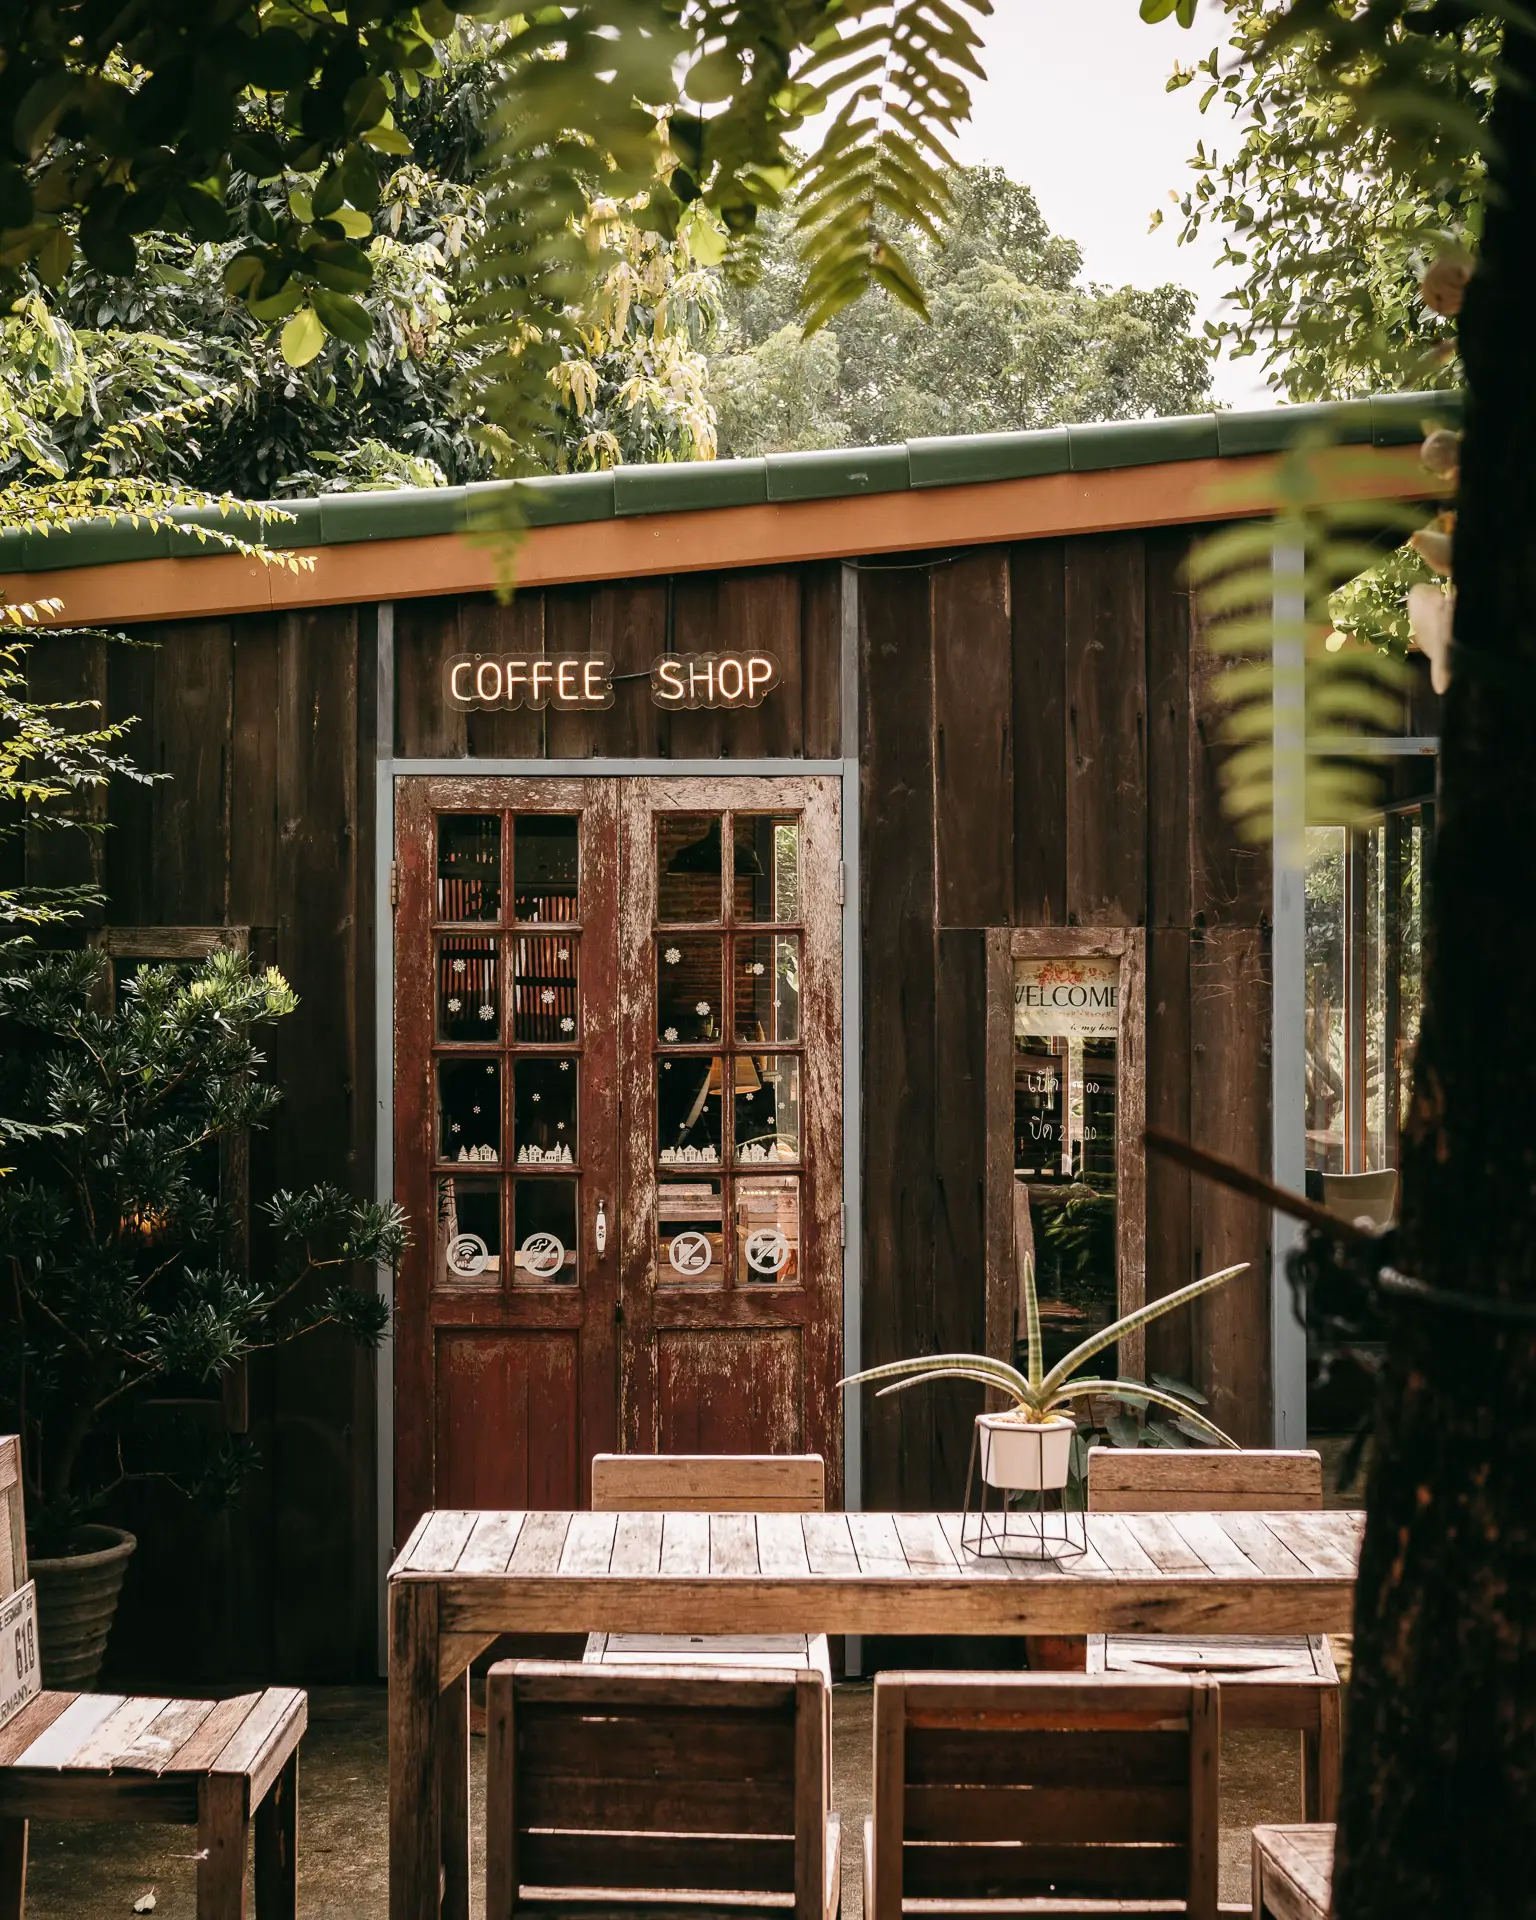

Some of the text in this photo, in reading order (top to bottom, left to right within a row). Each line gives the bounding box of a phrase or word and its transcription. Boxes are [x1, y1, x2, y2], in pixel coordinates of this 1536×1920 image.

[451, 658, 772, 701] COFFEE SHOP
[1081, 1025, 1095, 1033] my
[14, 1616, 35, 1680] 618
[0, 1684, 28, 1722] RMANY
